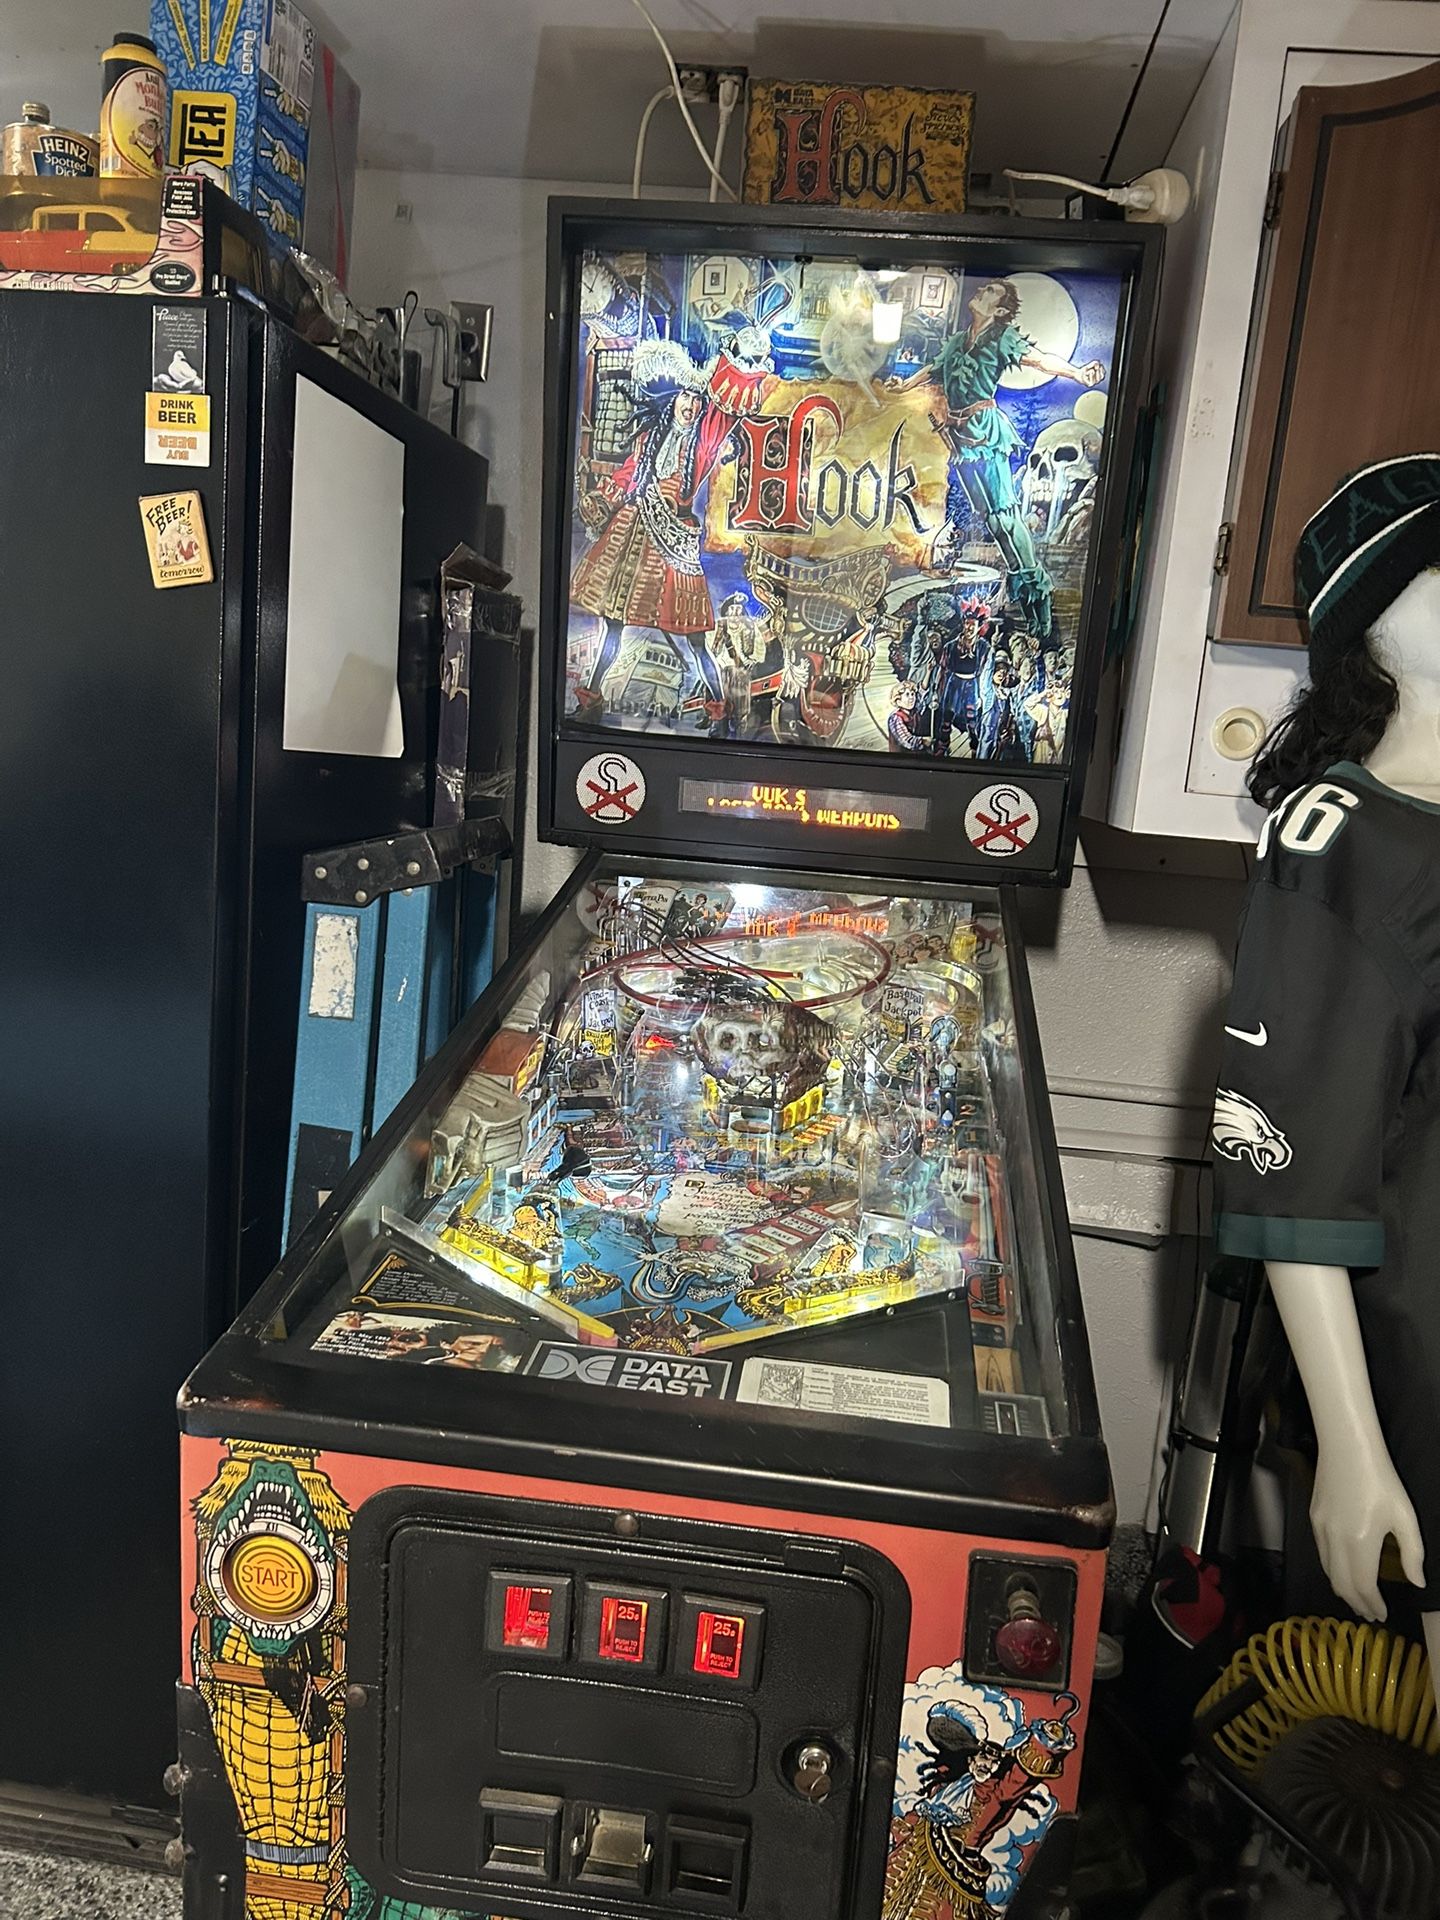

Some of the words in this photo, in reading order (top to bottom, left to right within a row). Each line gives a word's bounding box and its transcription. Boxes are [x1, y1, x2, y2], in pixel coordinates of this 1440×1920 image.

[179, 104, 227, 165] TEA
[43, 138, 88, 161] HEINZ
[769, 88, 936, 205] Hook
[44, 152, 86, 172] Spotted
[55, 165, 78, 176] Dick
[160, 399, 194, 410] DRINK
[158, 411, 196, 424] BEER
[728, 393, 935, 535] Hook
[146, 497, 176, 528] FREE
[155, 500, 192, 536] BEER!
[622, 1358, 710, 1381] DATA
[617, 1376, 712, 1397] EAST
[242, 1564, 298, 1588] START
[614, 1637, 630, 1646] PUSH
[615, 1644, 636, 1652] REJECT
[710, 1652, 725, 1661] PUSH
[710, 1659, 731, 1668] REJECT
